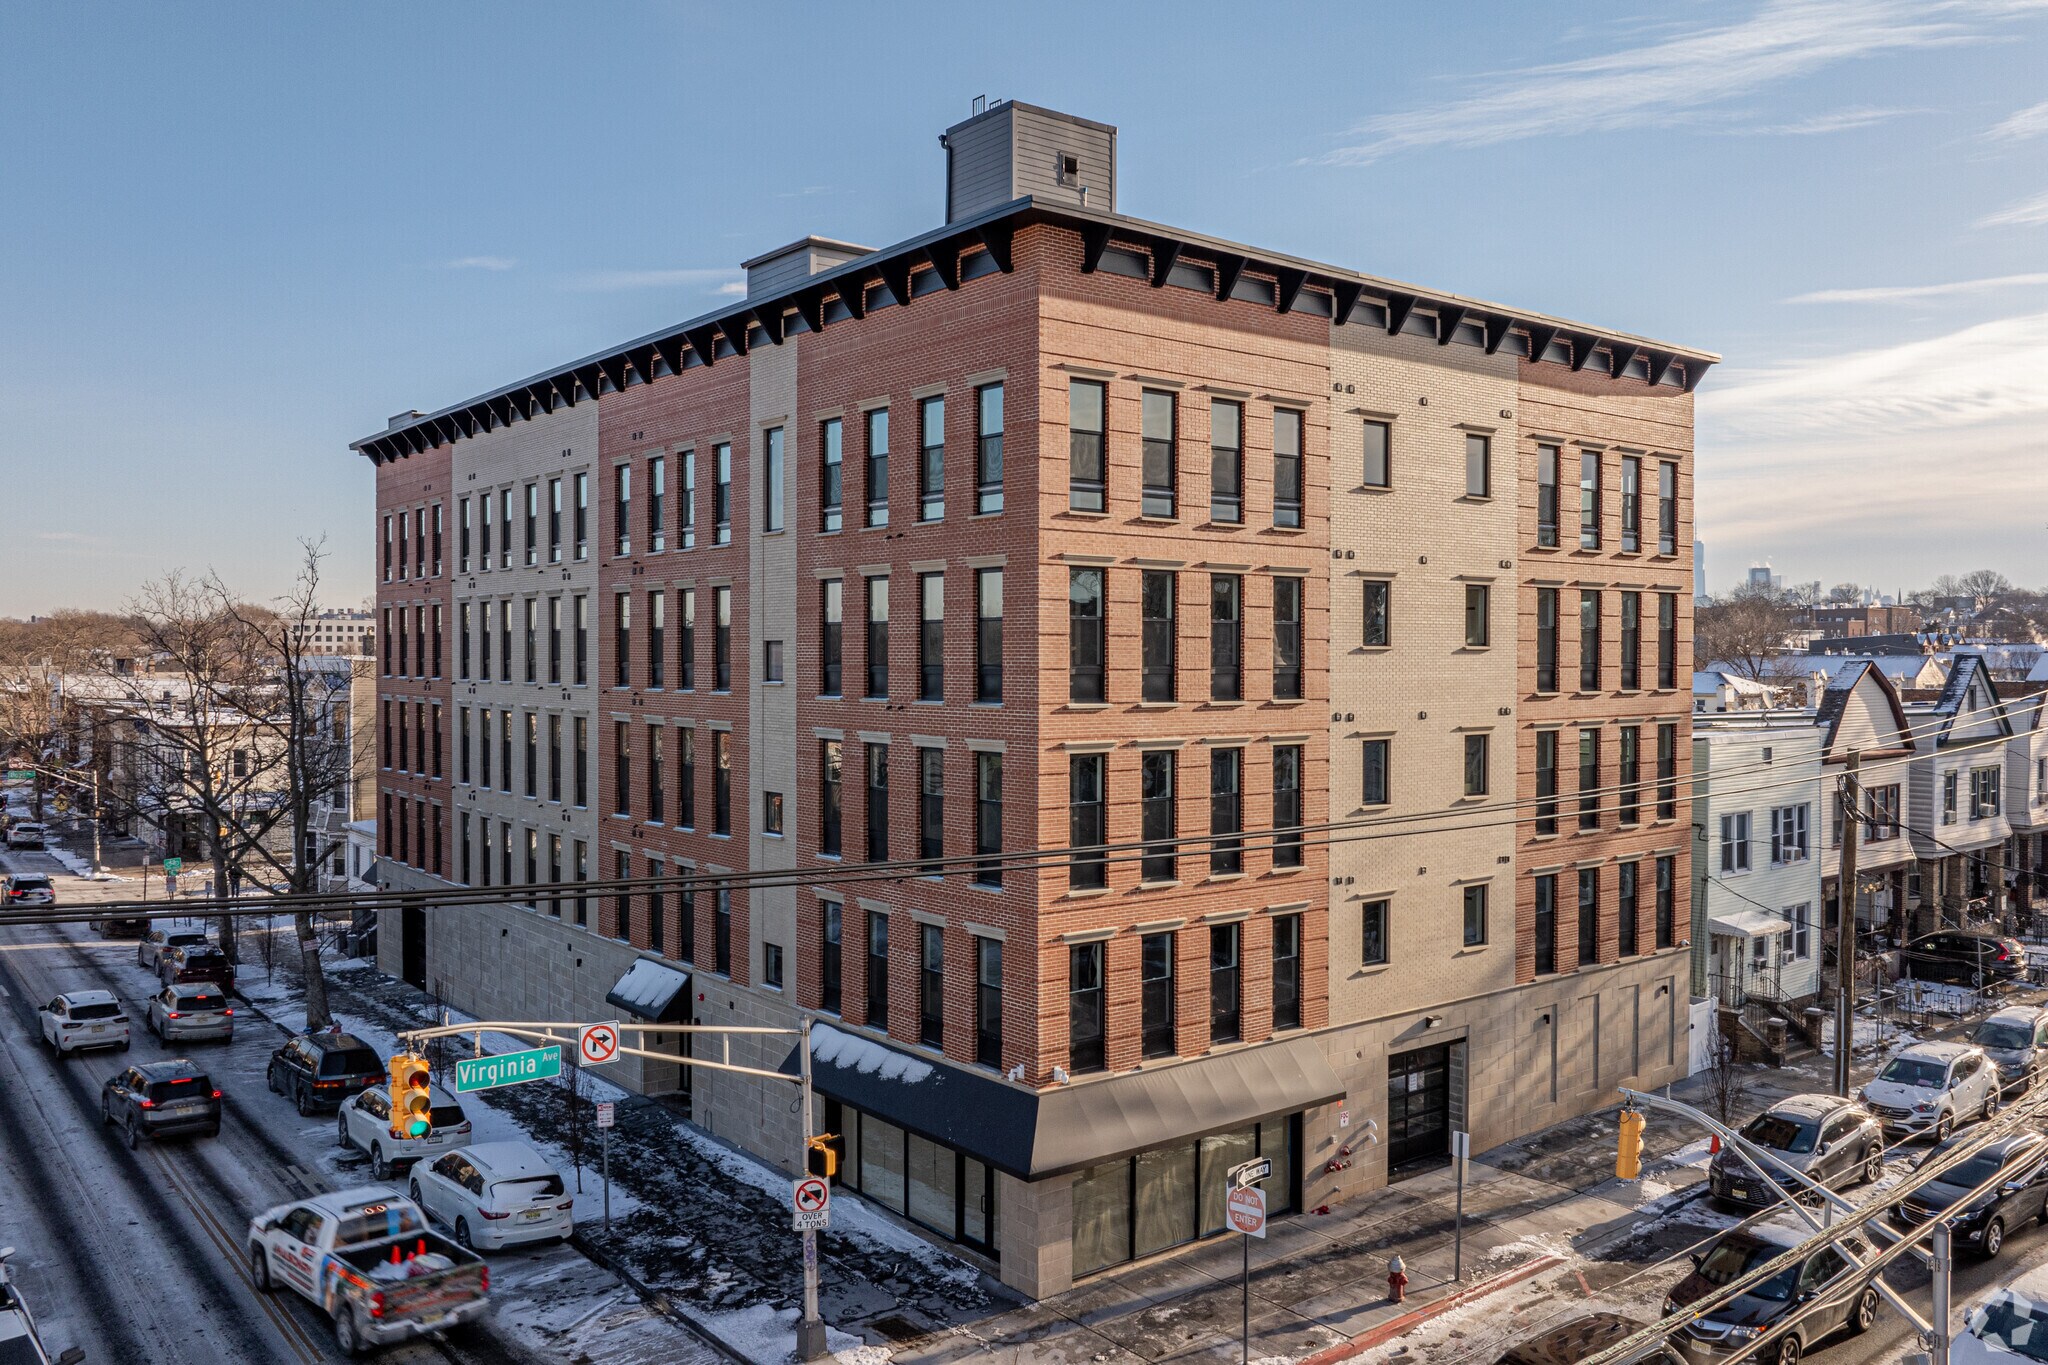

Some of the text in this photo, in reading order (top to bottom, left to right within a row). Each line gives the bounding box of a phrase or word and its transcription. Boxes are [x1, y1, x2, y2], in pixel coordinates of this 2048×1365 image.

[459, 1052, 558, 1085] Virginia Ave
[1245, 1165, 1267, 1180] ONE WAY
[1233, 1192, 1258, 1206] DO NOT
[802, 1212, 823, 1220] OVER
[1235, 1213, 1257, 1227] ENTER
[805, 1219, 827, 1228] TONS
